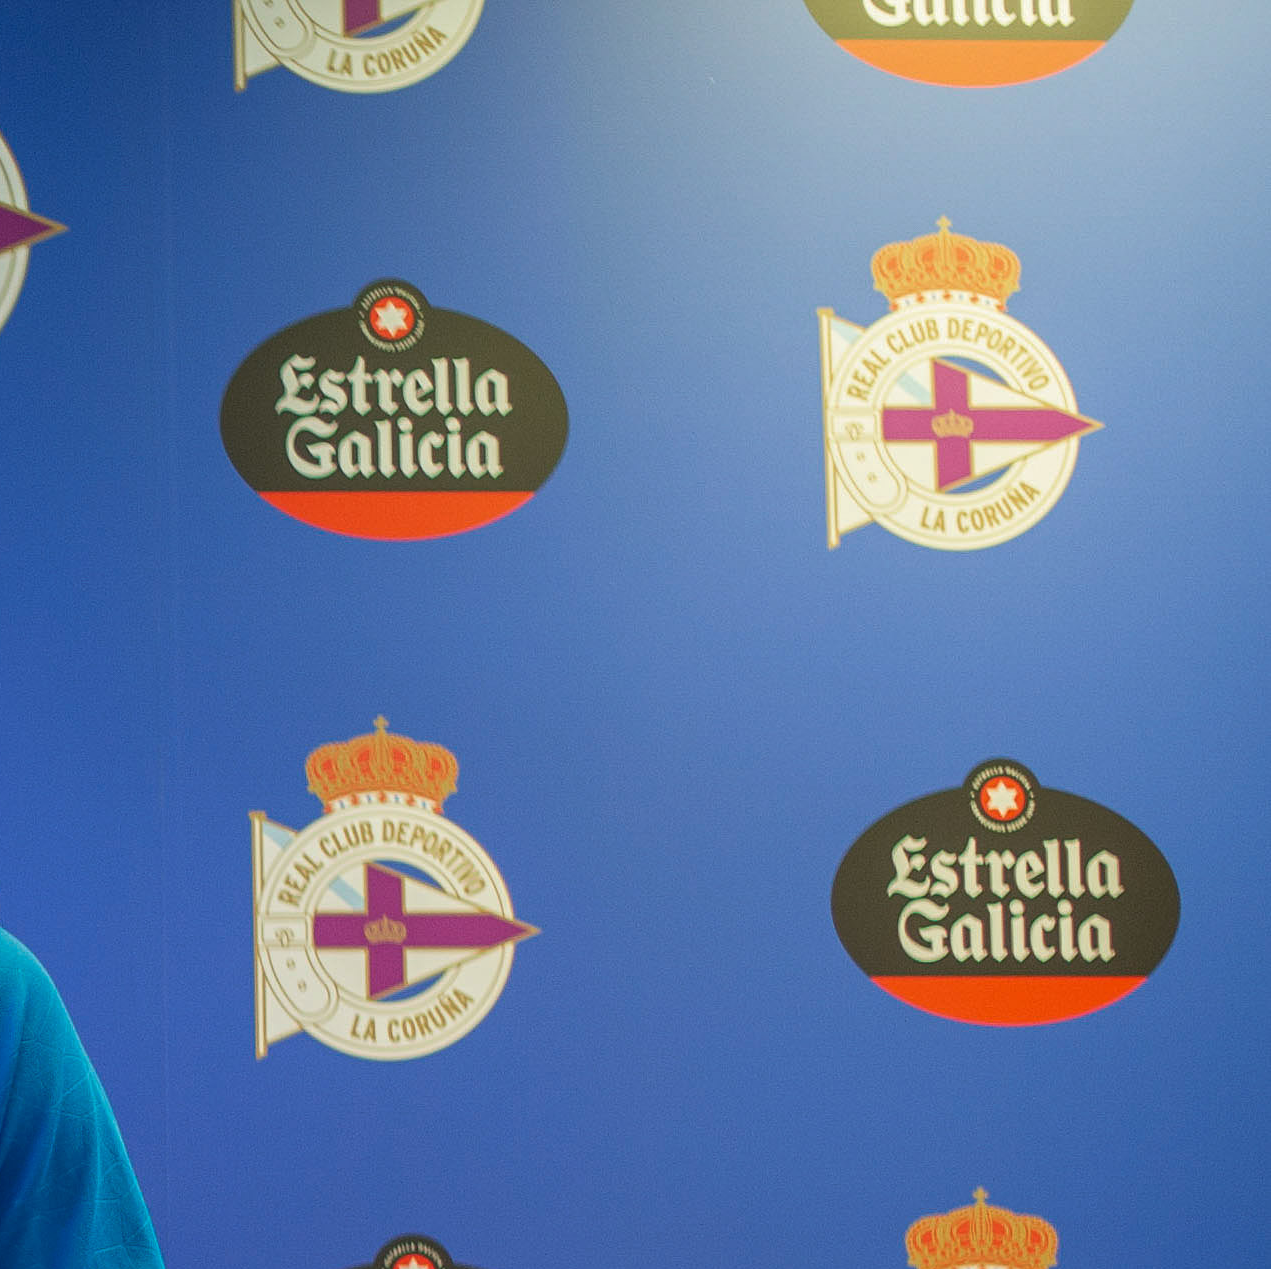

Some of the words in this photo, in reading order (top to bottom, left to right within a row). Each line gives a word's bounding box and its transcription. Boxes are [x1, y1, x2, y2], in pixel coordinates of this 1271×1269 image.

[326, 49, 353, 77] LA
[363, 26, 449, 77] CORUÑA
[275, 355, 512, 415] Estrella
[847, 349, 892, 401] REAL
[887, 318, 941, 354] CLUB
[947, 317, 1050, 391] DEPORTIVO
[286, 417, 504, 477] Galicia
[919, 505, 946, 533] LA
[956, 481, 1041, 534] CORUÑA
[278, 853, 325, 907] REAL
[320, 821, 375, 858] CLUB
[382, 819, 487, 895] DEPORTIVO
[886, 837, 1123, 897] Estrella
[897, 900, 1116, 961] Galicia
[350, 1014, 377, 1043] LA
[388, 988, 475, 1043] CORUÑA
